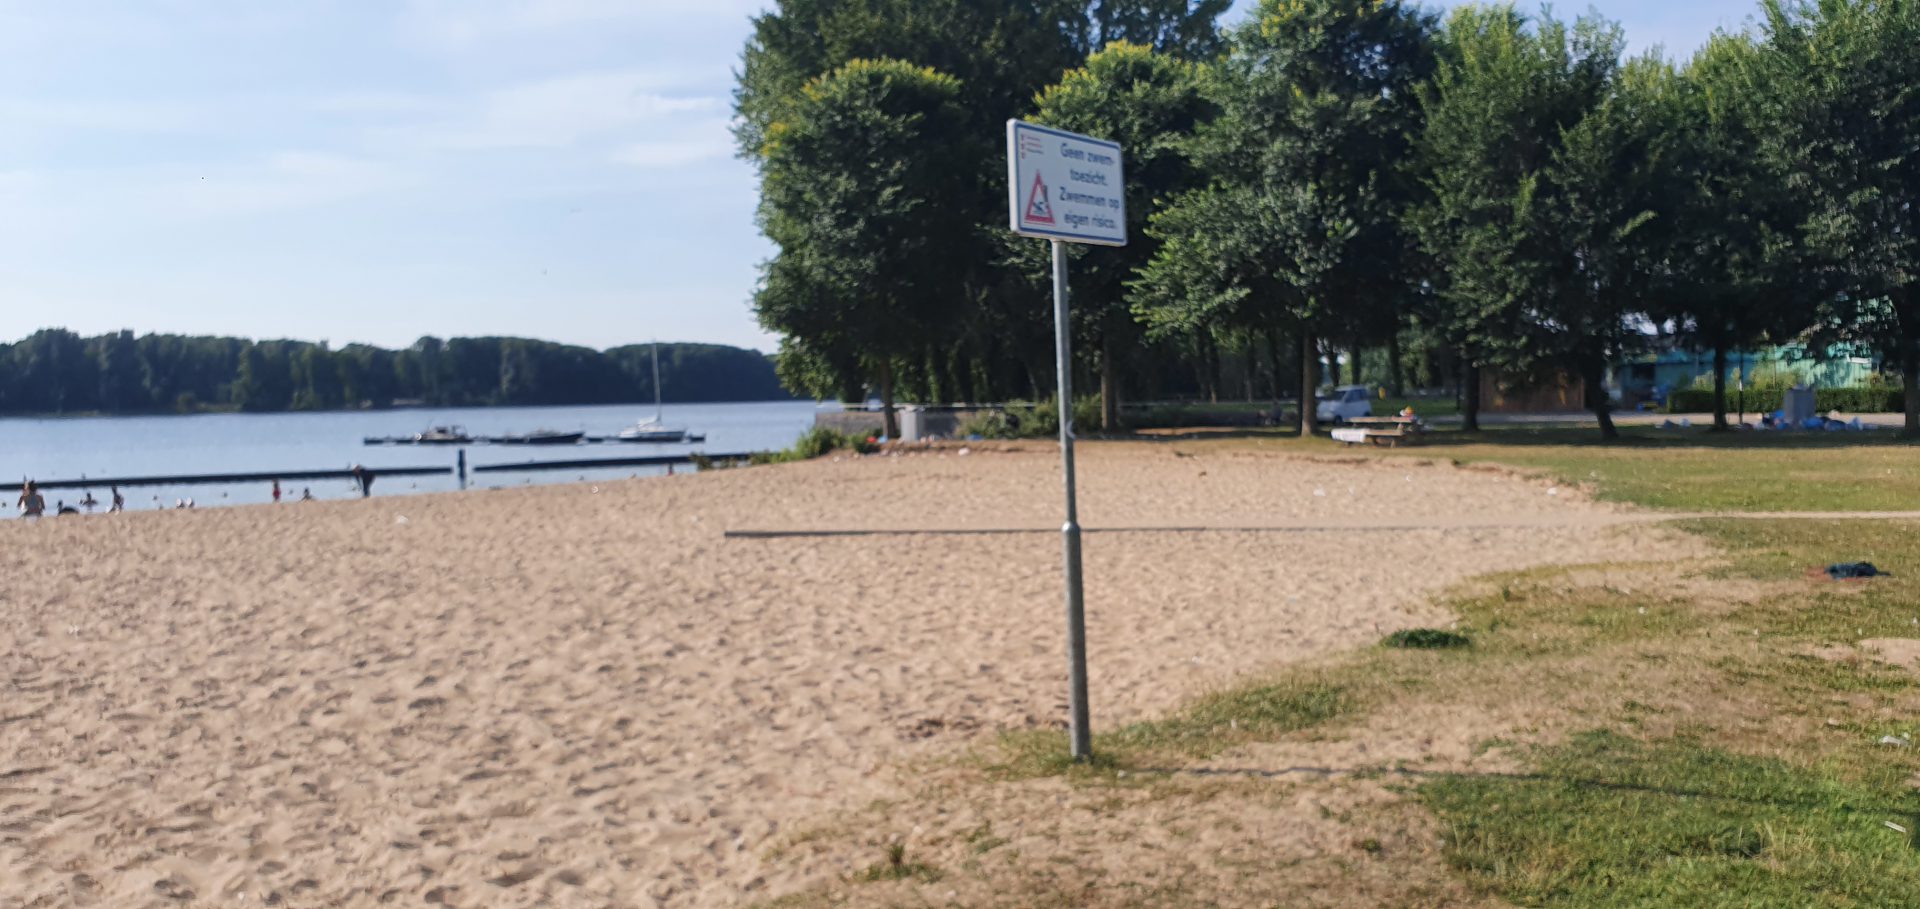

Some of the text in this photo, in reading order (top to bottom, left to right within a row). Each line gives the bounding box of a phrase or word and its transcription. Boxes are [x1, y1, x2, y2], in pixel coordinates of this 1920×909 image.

[1061, 142, 1084, 160] Geen
[1087, 152, 1115, 166] zwem-
[1070, 169, 1108, 186] toezicht.
[1060, 186, 1120, 213] Zwemmen op
[1064, 210, 1118, 229] eigen risico.
